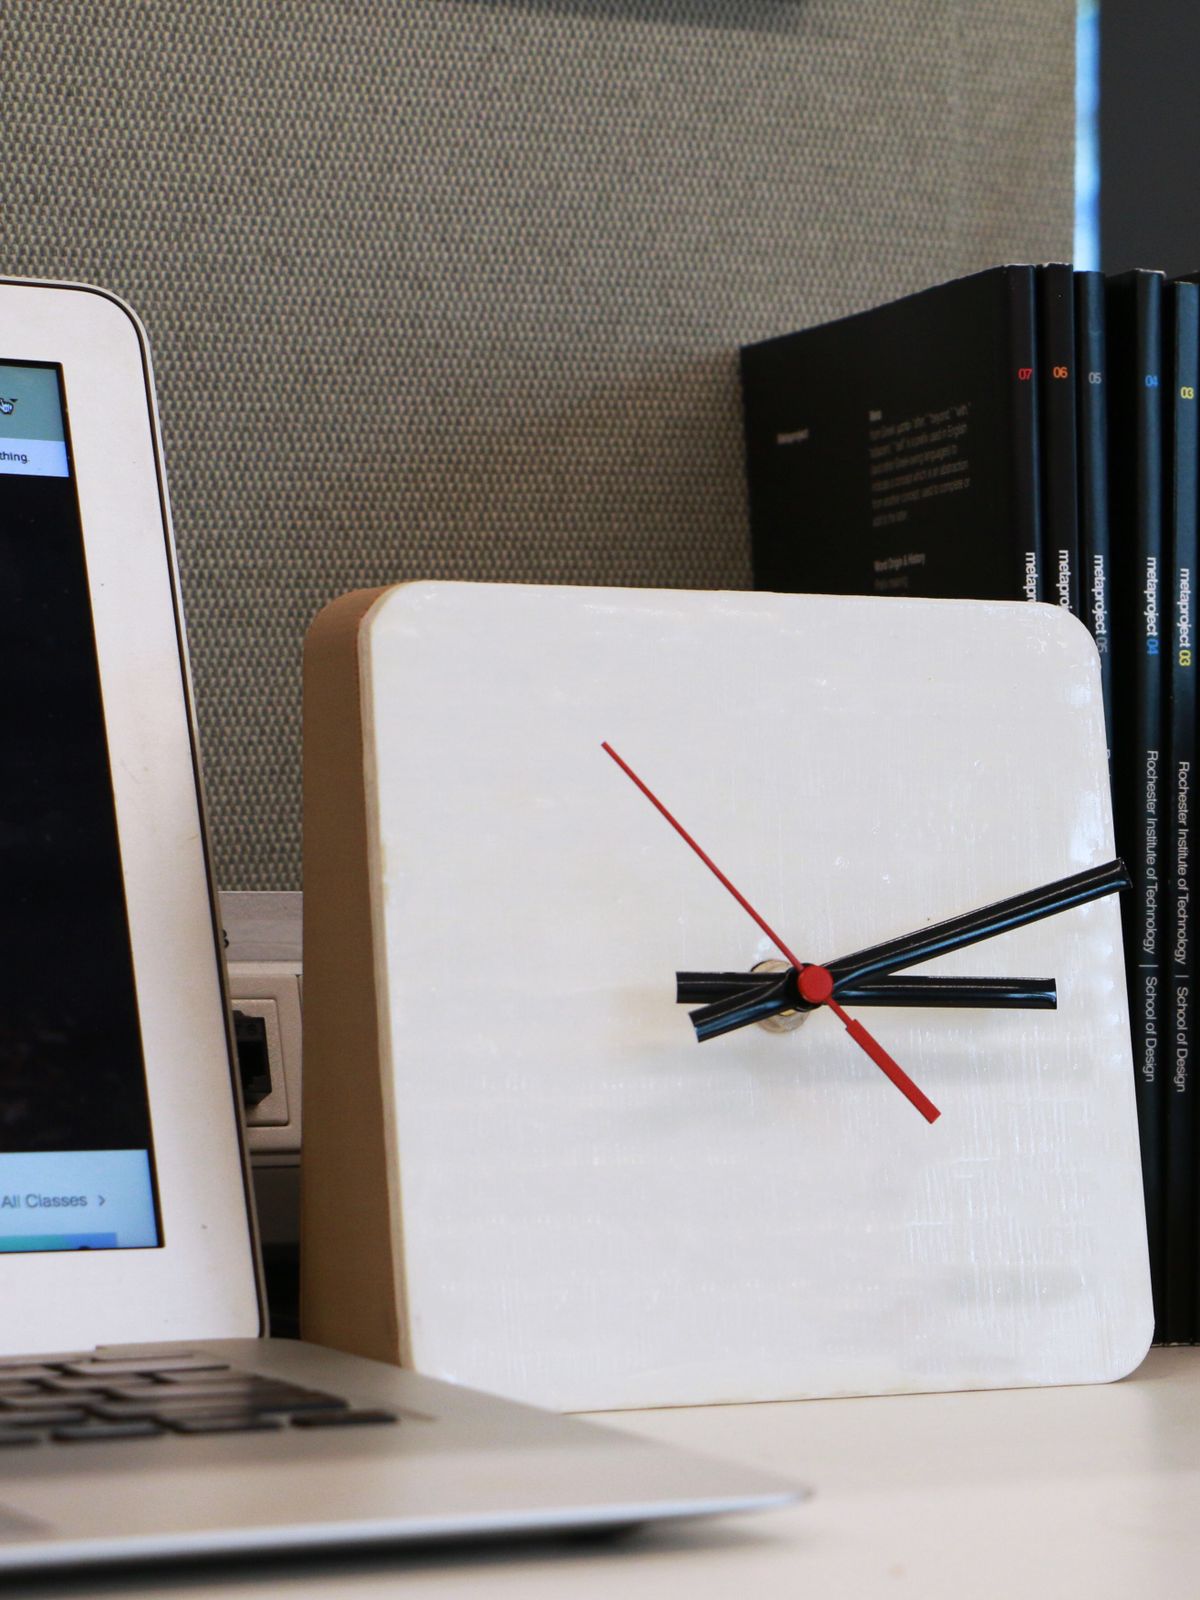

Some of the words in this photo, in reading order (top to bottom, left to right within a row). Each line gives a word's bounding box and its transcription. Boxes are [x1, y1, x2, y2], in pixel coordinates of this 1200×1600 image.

[1018, 367, 1033, 380] 07
[1053, 366, 1068, 378] 06
[1088, 371, 1102, 384] 05
[1145, 374, 1158, 387] 04
[1180, 386, 1194, 399] 03
[1023, 552, 1038, 602] metapr
[1055, 549, 1072, 609] metapro
[1091, 554, 1107, 634] metaproject
[1143, 556, 1159, 637] metaproject
[1177, 568, 1192, 648] metaproject
[1147, 638, 1158, 655] 04
[1179, 649, 1191, 666] 03
[1146, 750, 1158, 815] Rochester
[1178, 761, 1190, 826] Rochester
[1146, 818, 1158, 865] Institute
[1177, 829, 1189, 876] Institute
[1145, 867, 1158, 880] of
[1177, 878, 1189, 891] of
[1143, 882, 1158, 954] Technology
[1174, 893, 1189, 965] Technology
[1145, 976, 1158, 1020] School
[1177, 986, 1189, 1030] School
[1145, 1022, 1157, 1035] of
[1177, 1032, 1188, 1045] of
[1143, 1038, 1157, 1082] Design
[1174, 1048, 1188, 1093] Design
[1, 1194, 21, 1208] All
[25, 1192, 88, 1208] Classes
